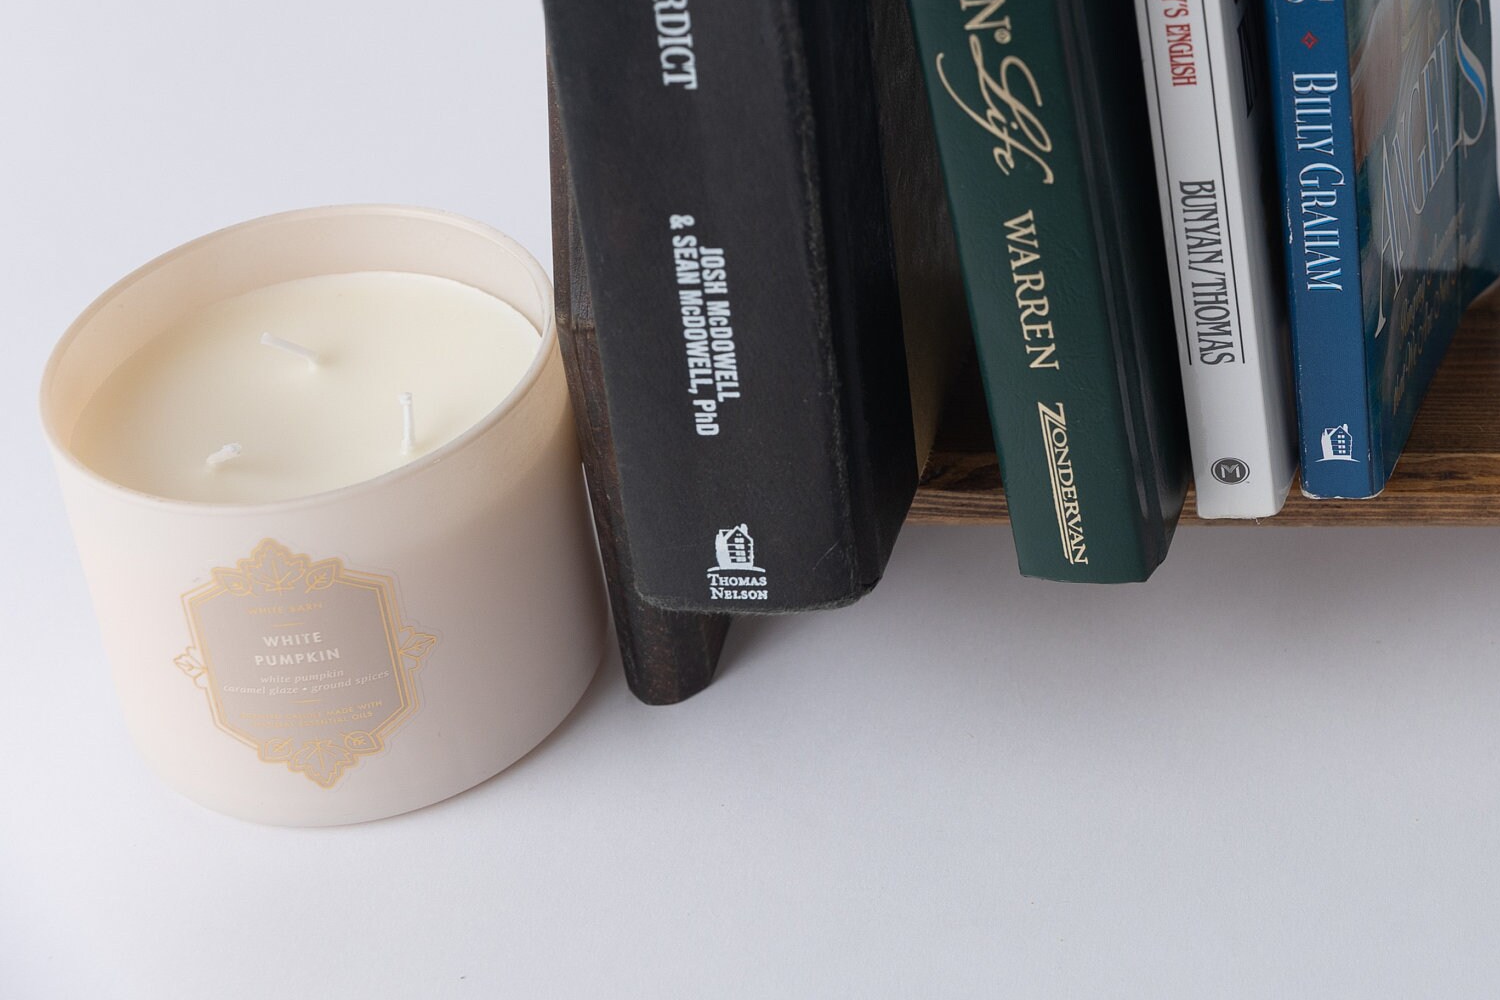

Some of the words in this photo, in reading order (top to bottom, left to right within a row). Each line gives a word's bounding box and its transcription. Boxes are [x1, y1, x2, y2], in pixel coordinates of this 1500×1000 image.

[1165, 24, 1197, 87] ENGLISH
[936, 34, 1054, 184] Life
[1291, 71, 1338, 157] BILLY
[669, 214, 694, 230] &
[1297, 161, 1346, 292] GRAHAM
[673, 234, 699, 285] SEAN
[700, 246, 728, 294] JOSH
[1003, 210, 1060, 370] WARREN
[679, 290, 714, 395] McDOWELL,
[706, 302, 740, 402] McDOWELL
[693, 399, 719, 437] PhD
[1038, 401, 1089, 565] ZONDERVAN
[707, 573, 767, 587] THOMAS
[710, 587, 768, 600] NELSON
[254, 648, 341, 666] PUMPKIN
[262, 631, 322, 648] WHITE
[260, 674, 291, 683] white
[294, 669, 344, 684] pumpkin
[311, 678, 351, 694] ground
[355, 669, 390, 685] spices
